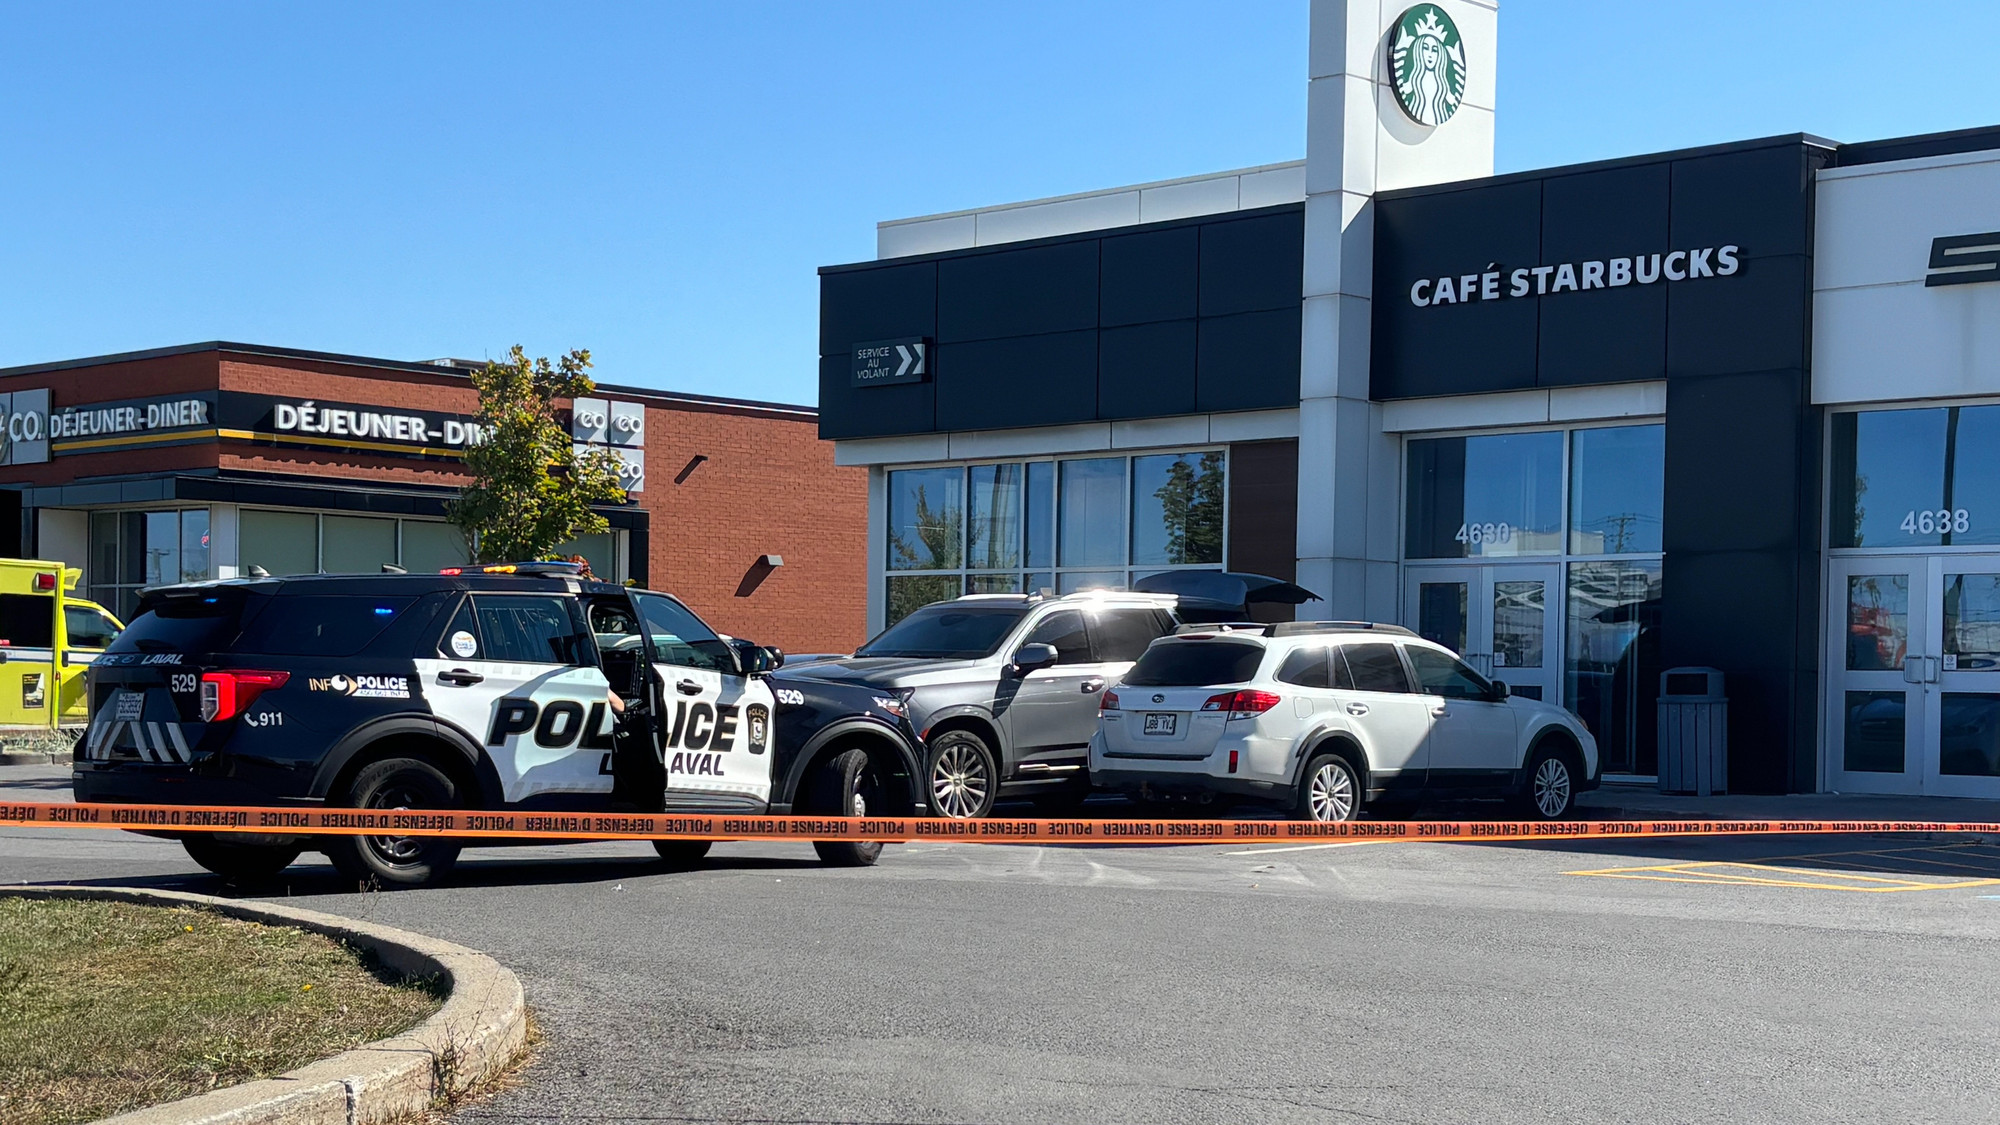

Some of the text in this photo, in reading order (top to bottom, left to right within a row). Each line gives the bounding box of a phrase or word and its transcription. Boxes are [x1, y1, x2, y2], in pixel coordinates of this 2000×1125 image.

[1410, 245, 1740, 308] CAFÉ STARBUCKS
[858, 346, 890, 359] SERVICE
[868, 359, 879, 368] AU
[857, 367, 890, 379] VOLANT
[51, 400, 205, 438] DÉJEUNER-DINER
[1900, 509, 1970, 535] 4638
[1455, 522, 1511, 545] 4630
[141, 653, 183, 665] LAVAL
[171, 674, 197, 693] 529
[357, 675, 408, 690] POLICE
[777, 688, 804, 706] 529
[260, 712, 283, 727] 911
[748, 707, 768, 720] POLICE
[49, 808, 99, 822] POLICE
[112, 809, 180, 825] D'ENTRER
[186, 811, 247, 829] DÉFENSE
[261, 812, 309, 827] POLICE
[321, 814, 388, 829] D'ENTRER
[394, 815, 453, 832] DÉFENSE
[467, 816, 514, 831] POLICE
[526, 817, 591, 831] D'ENTRER
[666, 819, 712, 833] POLICE
[724, 820, 787, 834] D'ENTRER
[860, 821, 905, 834] POLICE
[916, 822, 977, 834] D'ENTRER
[1049, 822, 1092, 835] POLICE
[1103, 822, 1163, 835] D'ENTRER
[1234, 823, 1277, 835] POLICE
[1288, 823, 1348, 836] D'ENTRER
[1417, 824, 1460, 835] POLICE
[1471, 824, 1530, 835] D'ENTRER
[1600, 824, 1642, 834] POLICE
